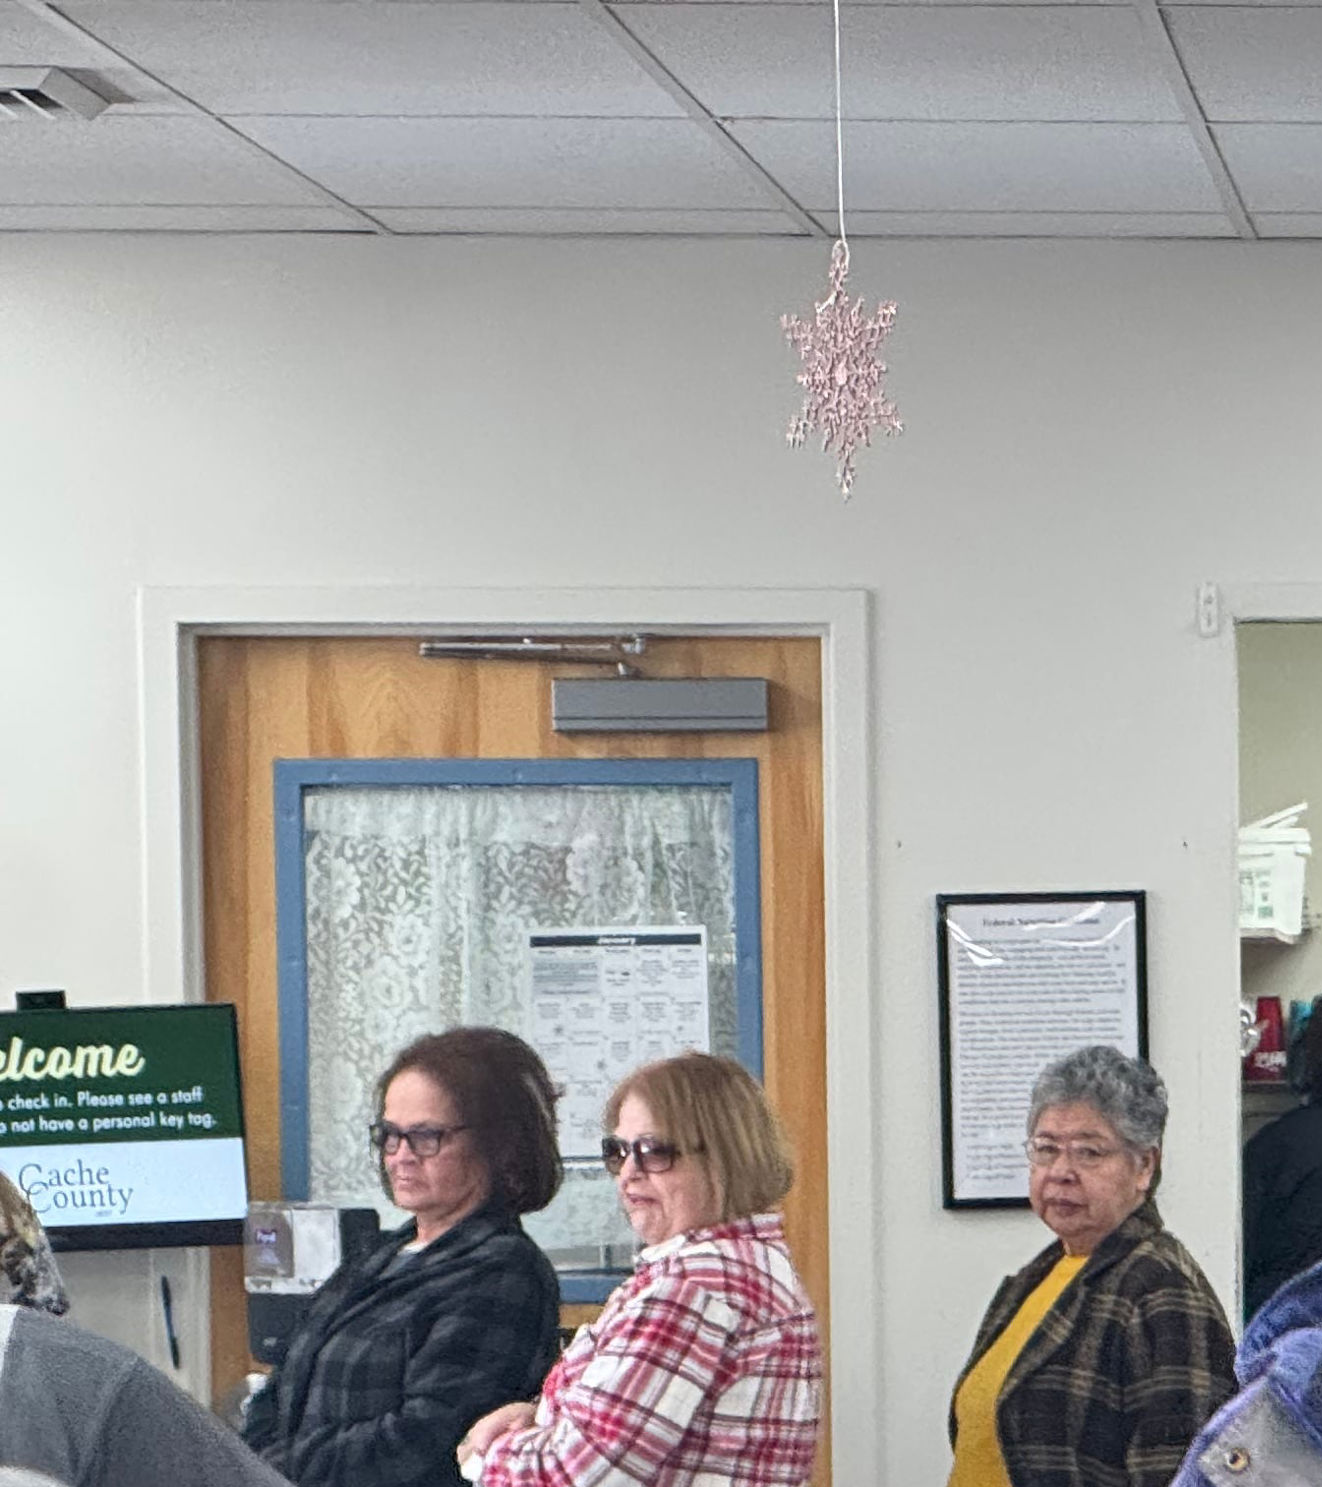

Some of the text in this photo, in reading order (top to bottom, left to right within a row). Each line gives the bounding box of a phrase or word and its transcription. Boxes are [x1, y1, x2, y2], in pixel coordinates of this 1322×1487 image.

[8, 1092, 50, 1110] check
[54, 1093, 73, 1108] in.
[77, 1091, 123, 1107] Please
[128, 1093, 154, 1106] see
[157, 1093, 167, 1105] a
[171, 1086, 204, 1104] staff
[11, 1118, 35, 1133] not
[39, 1115, 75, 1131] have
[78, 1118, 88, 1130] a
[93, 1111, 155, 1132] personal
[159, 1111, 184, 1129] key
[188, 1112, 218, 1129] tag.
[19, 1159, 109, 1195] Cache
[27, 1181, 133, 1215] County
